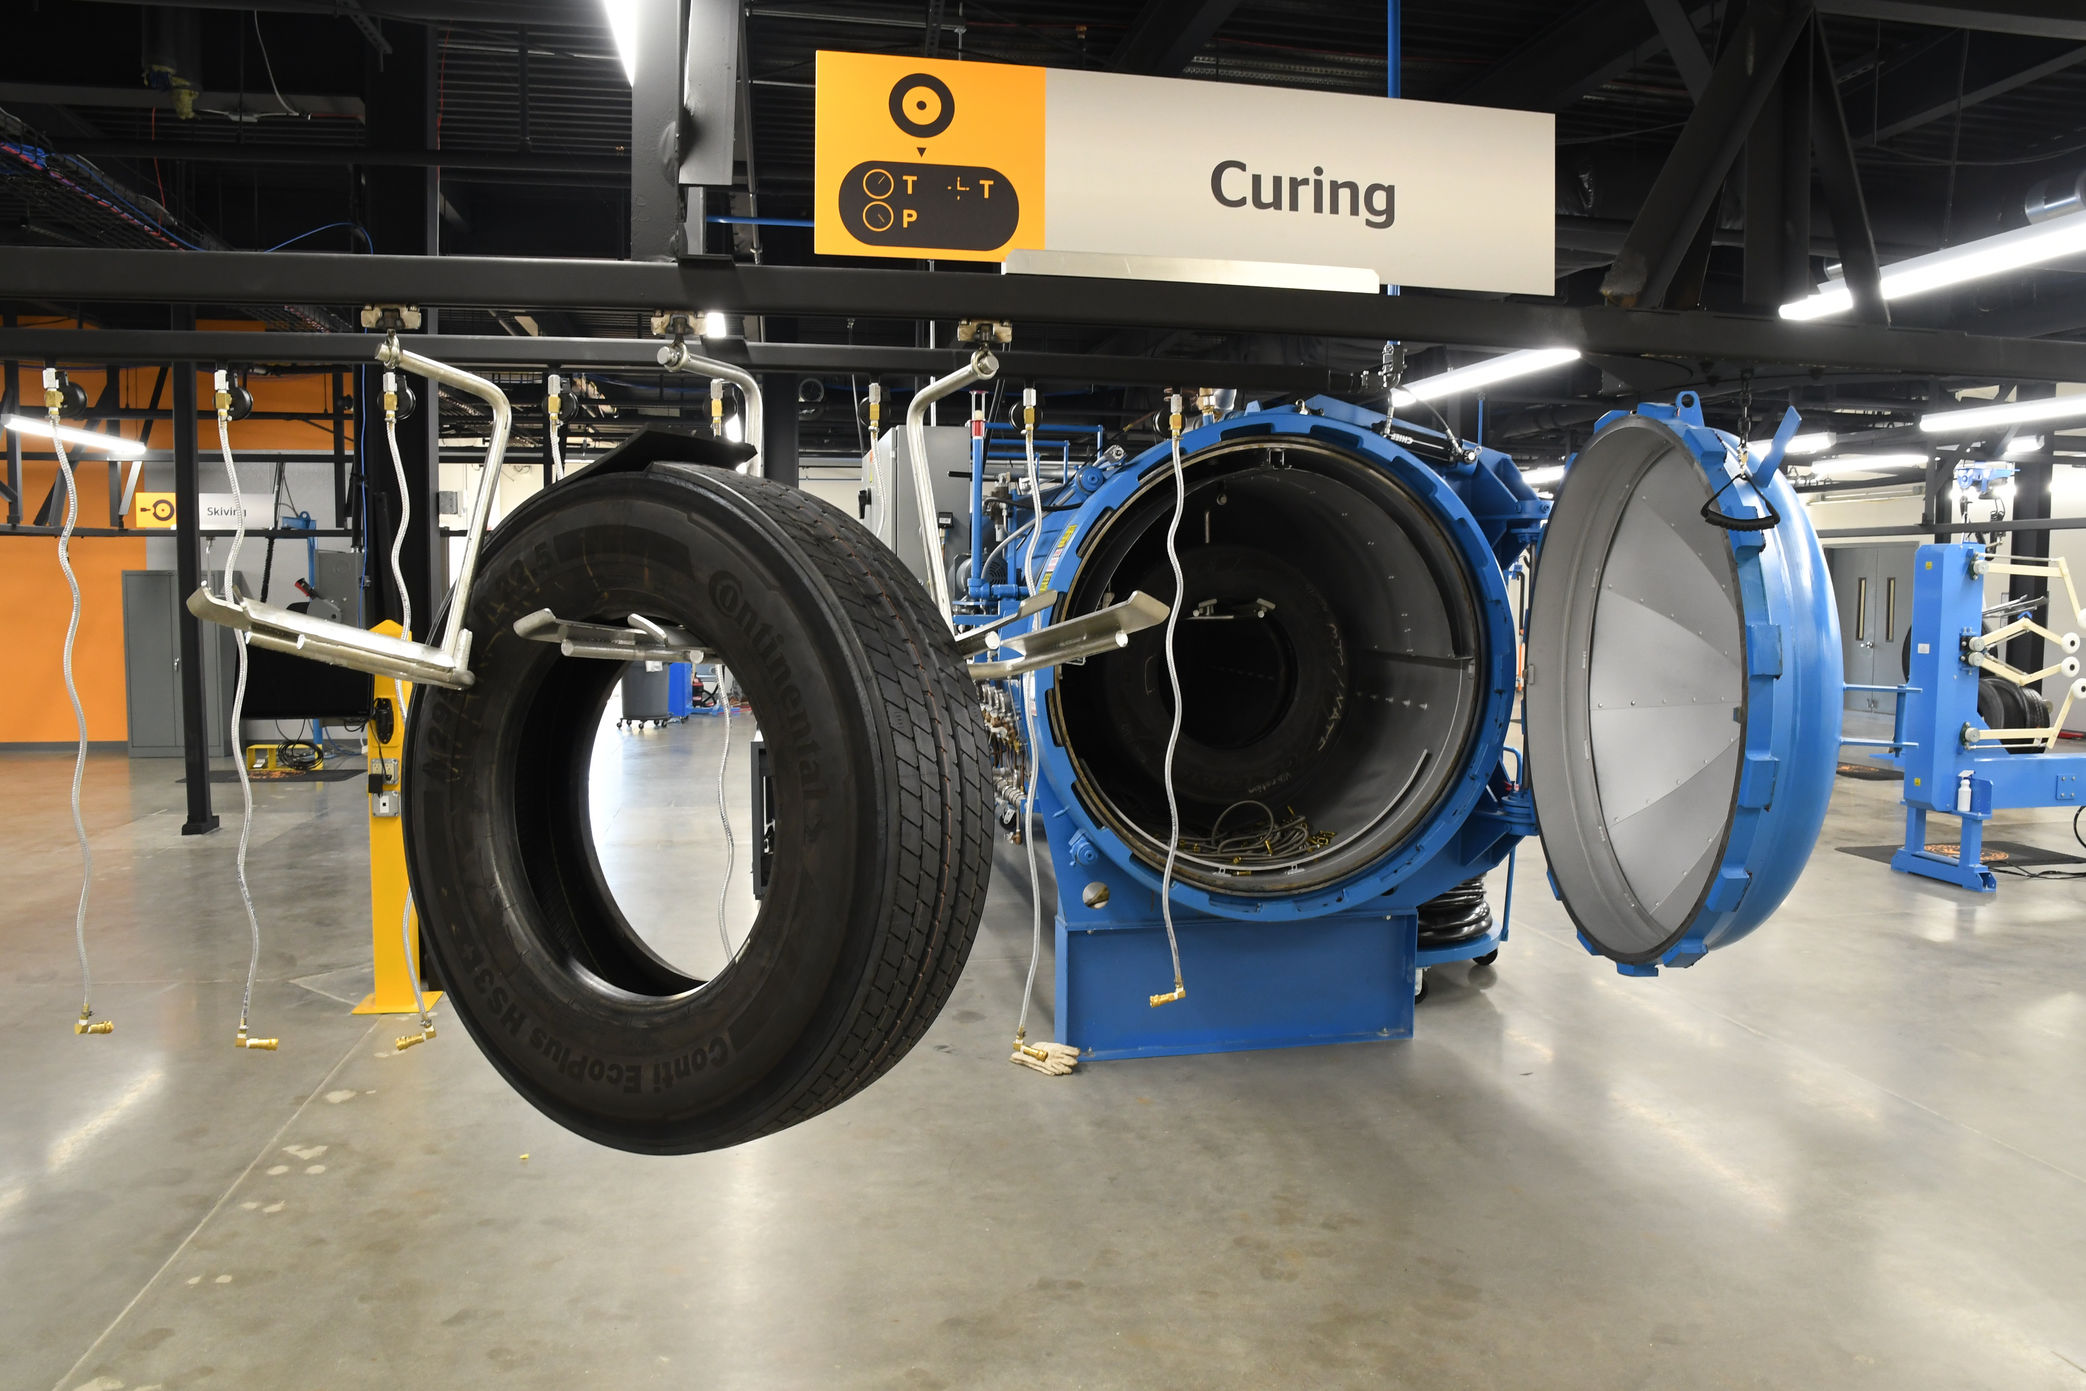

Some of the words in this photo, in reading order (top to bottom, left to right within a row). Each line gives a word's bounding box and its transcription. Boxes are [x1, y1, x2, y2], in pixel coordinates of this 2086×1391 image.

[902, 175, 918, 196] T
[979, 179, 994, 199] T
[1210, 159, 1397, 230] Curing
[902, 209, 918, 229] P
[207, 506, 248, 518] Skivi
[708, 569, 830, 802] Continental
[528, 1026, 643, 1095] EcoPlus
[652, 1035, 730, 1094] Conti
